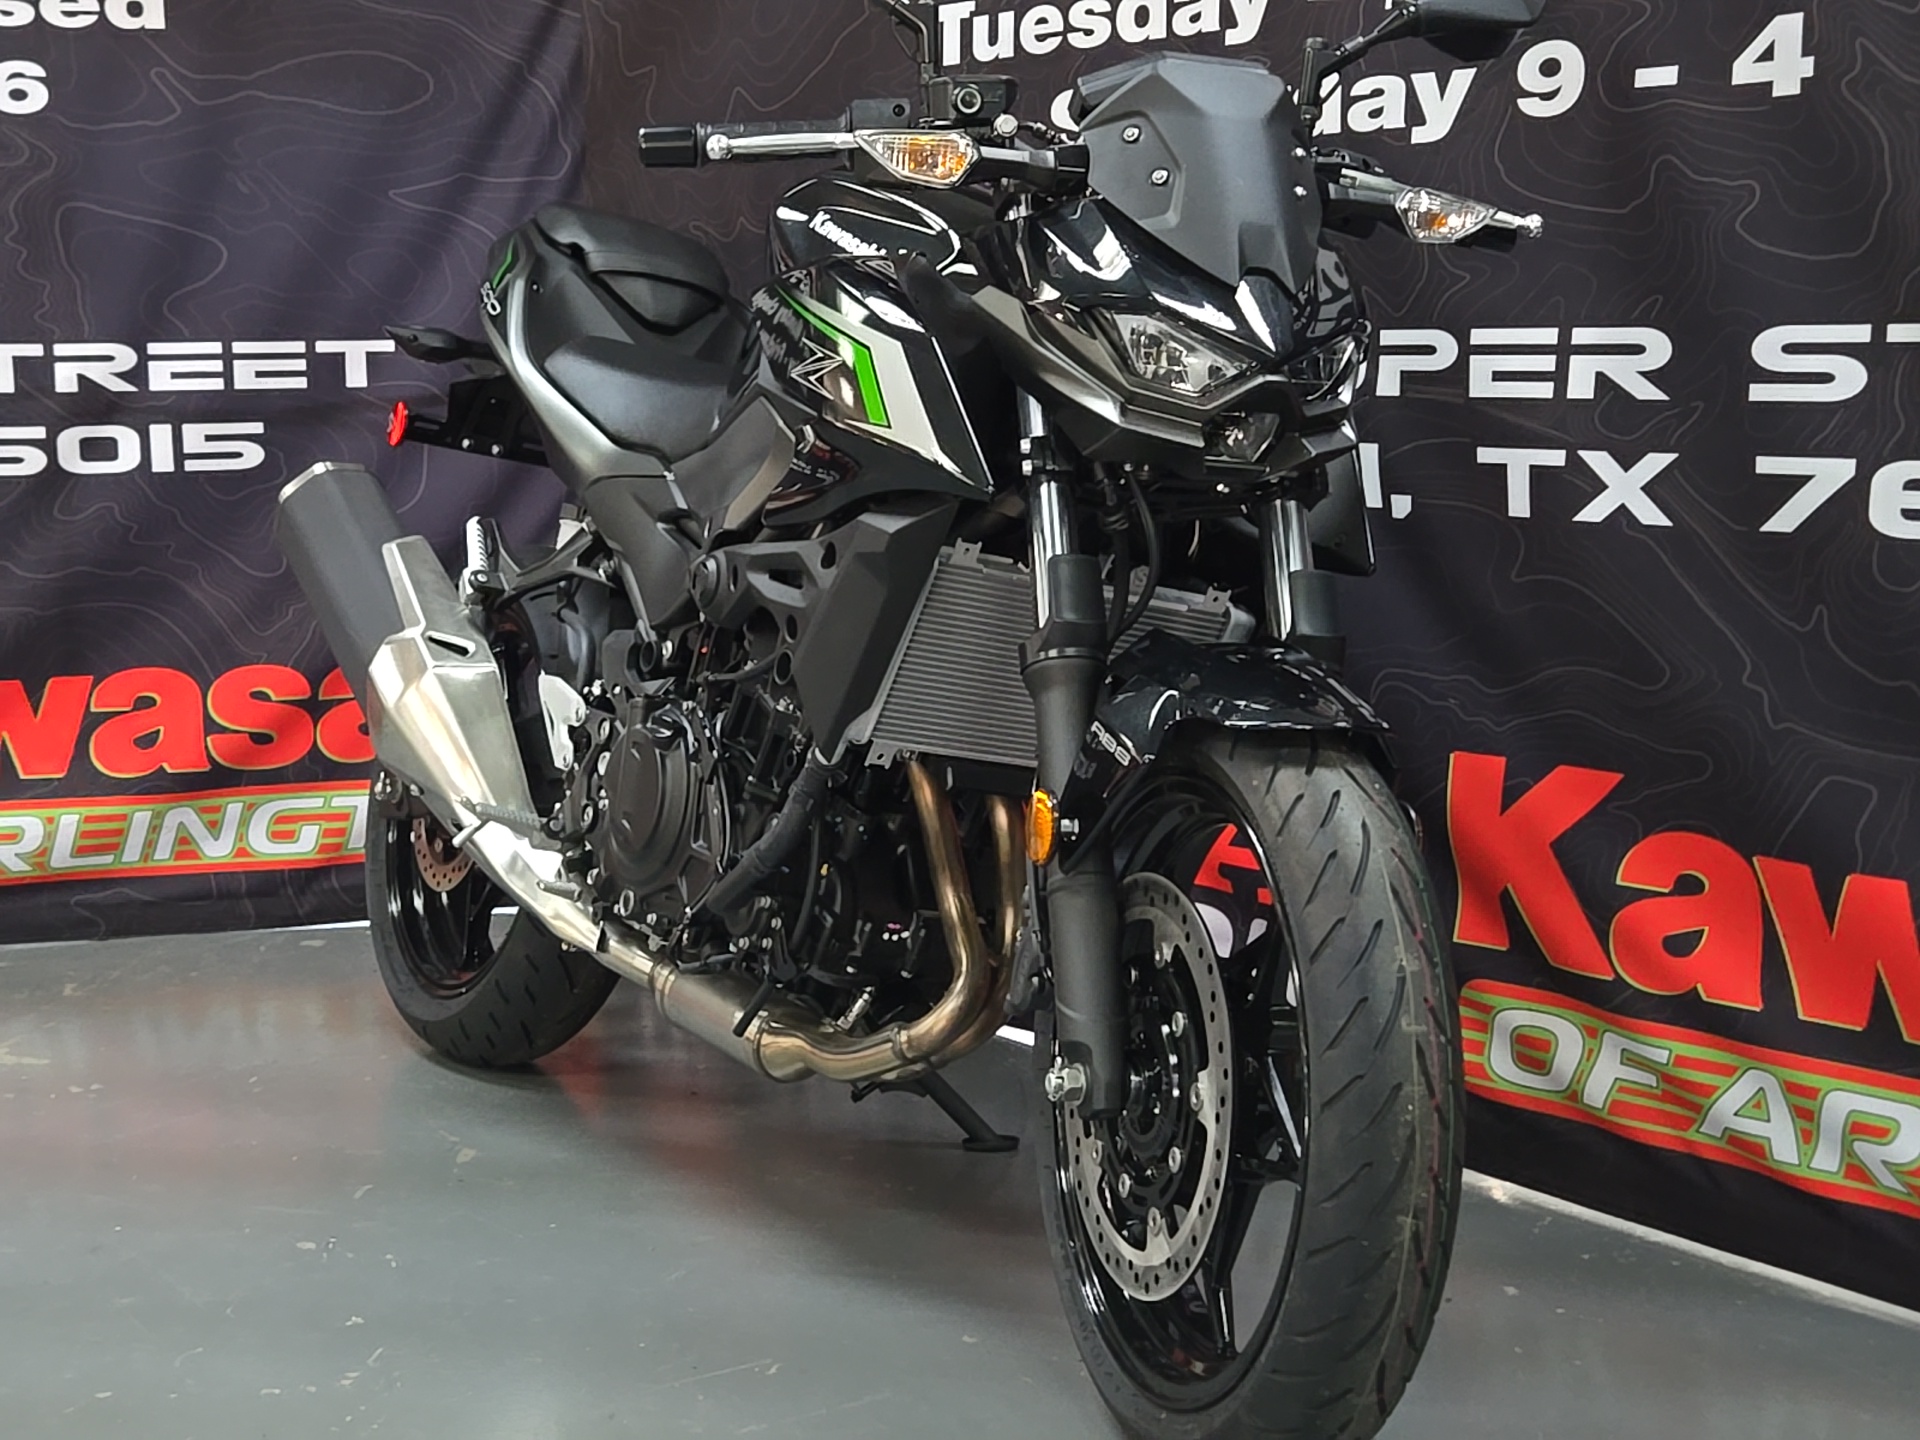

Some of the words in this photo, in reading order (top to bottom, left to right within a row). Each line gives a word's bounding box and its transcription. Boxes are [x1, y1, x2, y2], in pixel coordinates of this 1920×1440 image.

[938, 0, 1268, 66] Tuesday
[1516, 39, 1585, 117] 9
[1634, 65, 1679, 88] -
[1732, 12, 1815, 98] 4
[0, 60, 49, 115] 6
[0, 422, 265, 476] 5015
[1476, 446, 1679, 526] TX
[1447, 751, 1920, 1045] Kaw
[1489, 1009, 1671, 1110] OF
[1699, 1068, 1920, 1194] AR
